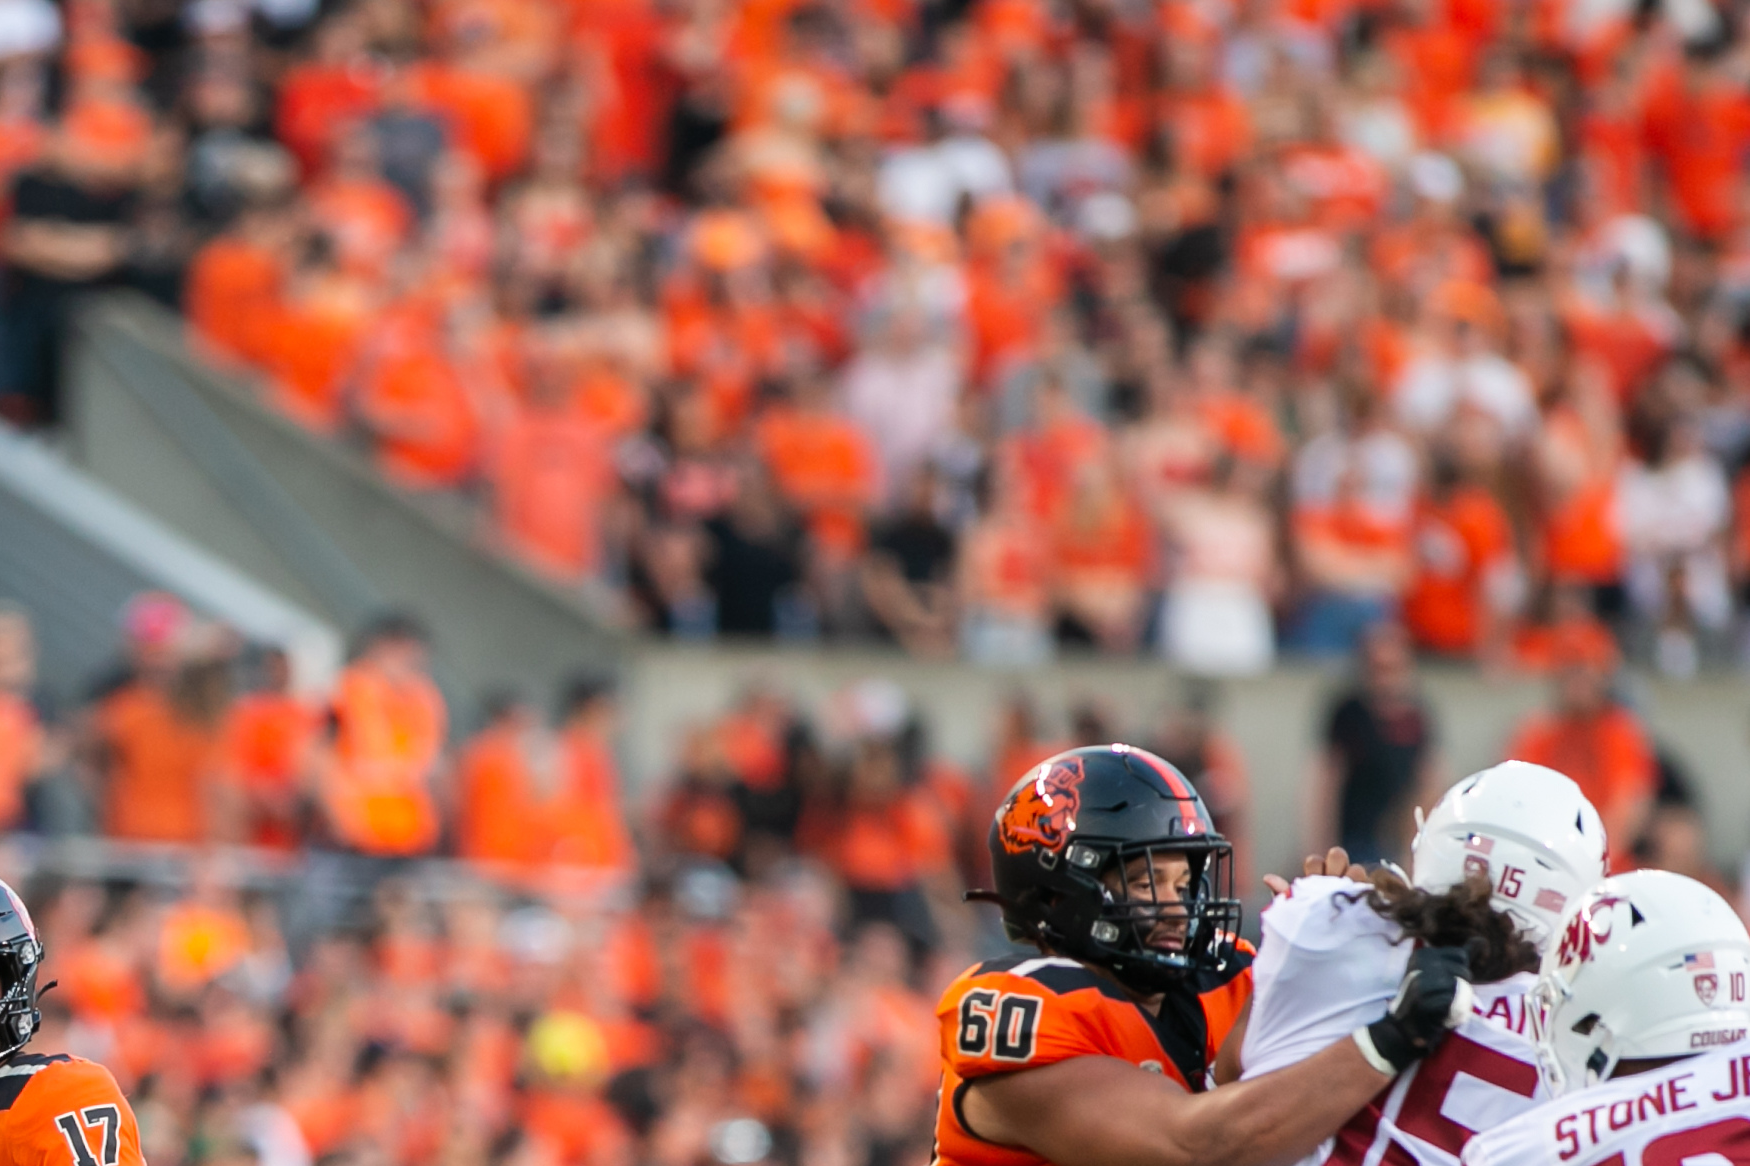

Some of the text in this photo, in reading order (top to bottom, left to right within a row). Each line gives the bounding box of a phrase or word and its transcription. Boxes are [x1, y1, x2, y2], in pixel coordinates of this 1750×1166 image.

[1496, 863, 1526, 899] 15
[1729, 971, 1746, 1003] 10
[956, 987, 1044, 1064] 60
[1555, 1071, 1698, 1161] STONE
